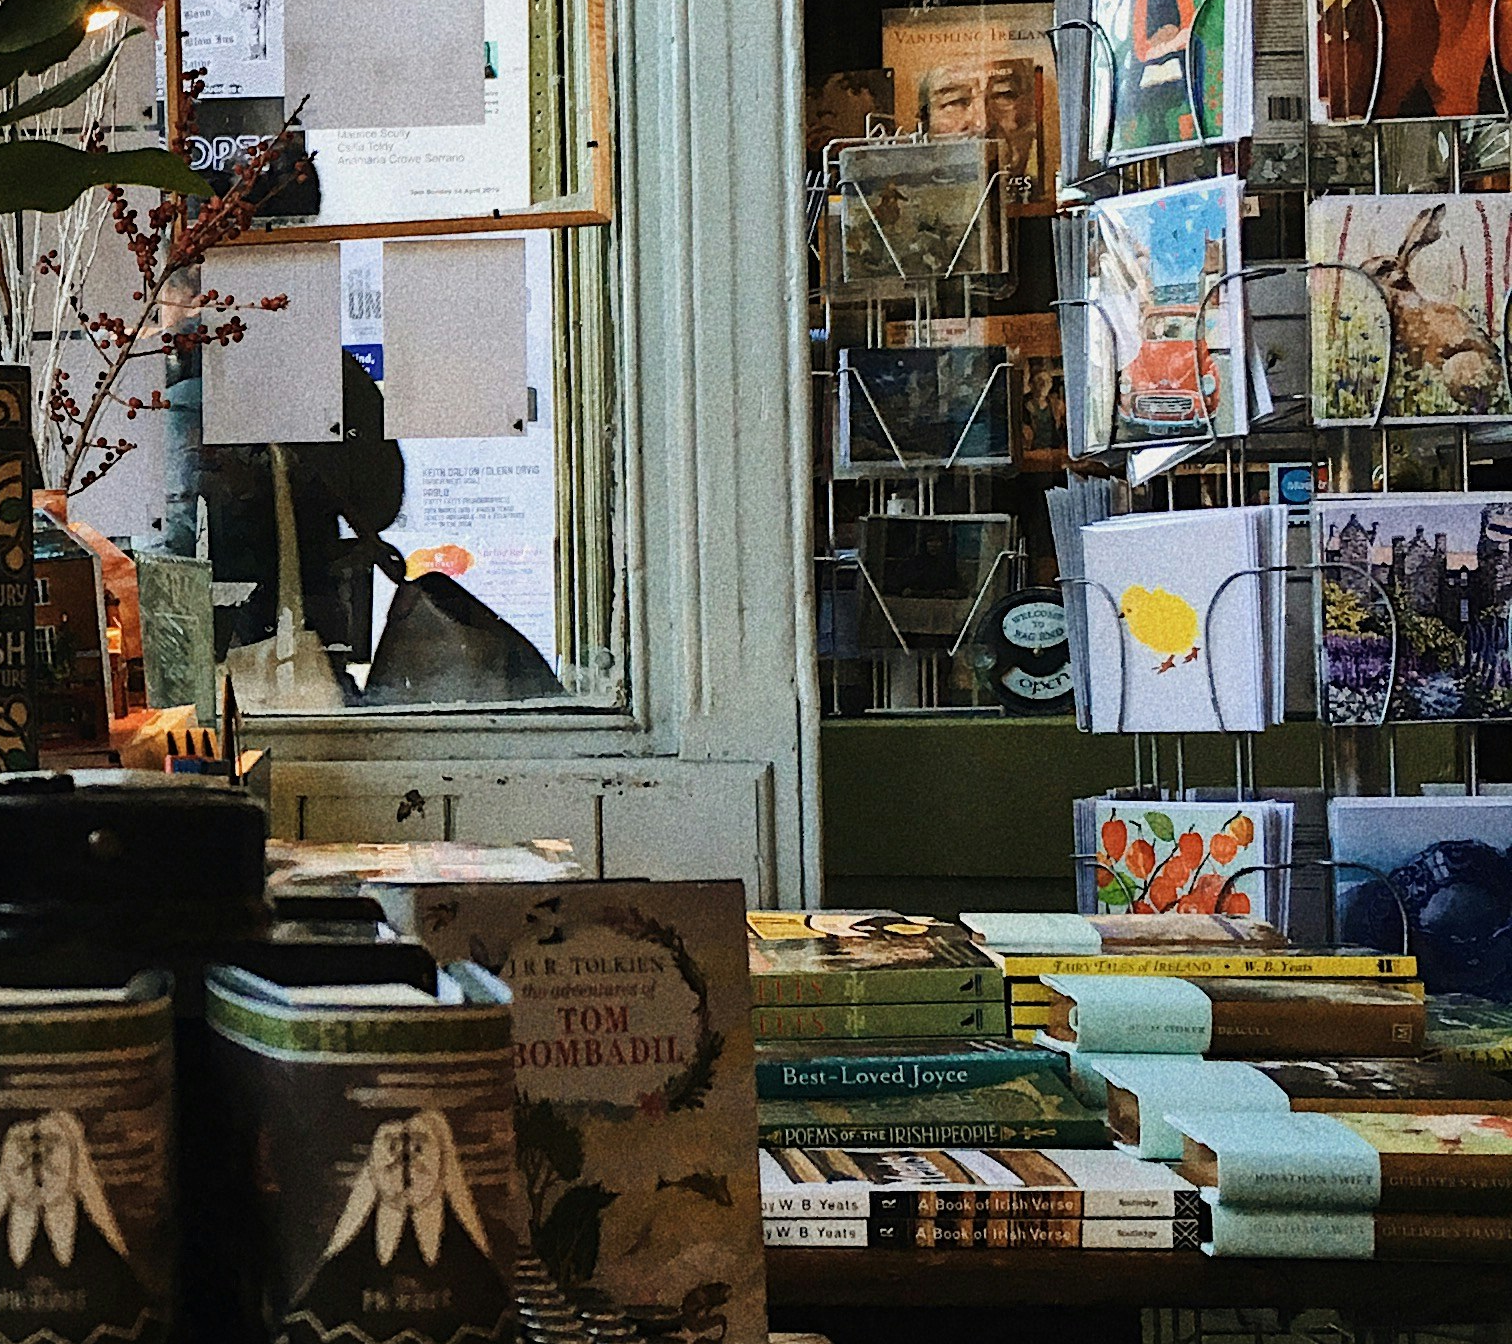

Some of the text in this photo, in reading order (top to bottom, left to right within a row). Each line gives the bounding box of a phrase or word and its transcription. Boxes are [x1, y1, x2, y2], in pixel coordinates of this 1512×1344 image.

[893, 28, 1047, 44] VANISHING IRELAN
[380, 128, 411, 140] Scully
[389, 154, 421, 164] Crowe
[1039, 627, 1065, 641] END
[1019, 672, 1071, 696] open
[569, 957, 665, 976] TOLKIEN
[1053, 959, 1090, 973] FAIRY
[1094, 959, 1135, 973] TALES
[1138, 959, 1150, 973] of
[1153, 959, 1212, 973] IRELAND
[1281, 960, 1314, 973] Yeats
[522, 982, 549, 1000] the
[557, 1005, 630, 1035] TOM
[1164, 1024, 1206, 1035] STOKER
[1218, 1026, 1271, 1036] DRACULA
[513, 1036, 685, 1069] BOMBADIL
[783, 1064, 968, 1089] Best-Loved Joyce
[784, 1126, 838, 1146] POEMS
[889, 1126, 934, 1145] IRISH
[939, 1124, 998, 1145] PEOPLE
[1334, 1174, 1374, 1186] SWIFT
[819, 1198, 859, 1212] Yeats
[918, 1198, 930, 1210] A
[935, 1197, 972, 1211] Book
[975, 1197, 990, 1212] of
[995, 1197, 1029, 1212] Irish
[1032, 1197, 1074, 1212] Verse
[816, 1225, 857, 1239] Yeats
[915, 1228, 927, 1240] A
[932, 1227, 970, 1241] Book
[973, 1227, 988, 1241] of
[992, 1226, 1027, 1241] Irish
[1029, 1226, 1072, 1241] Verse
